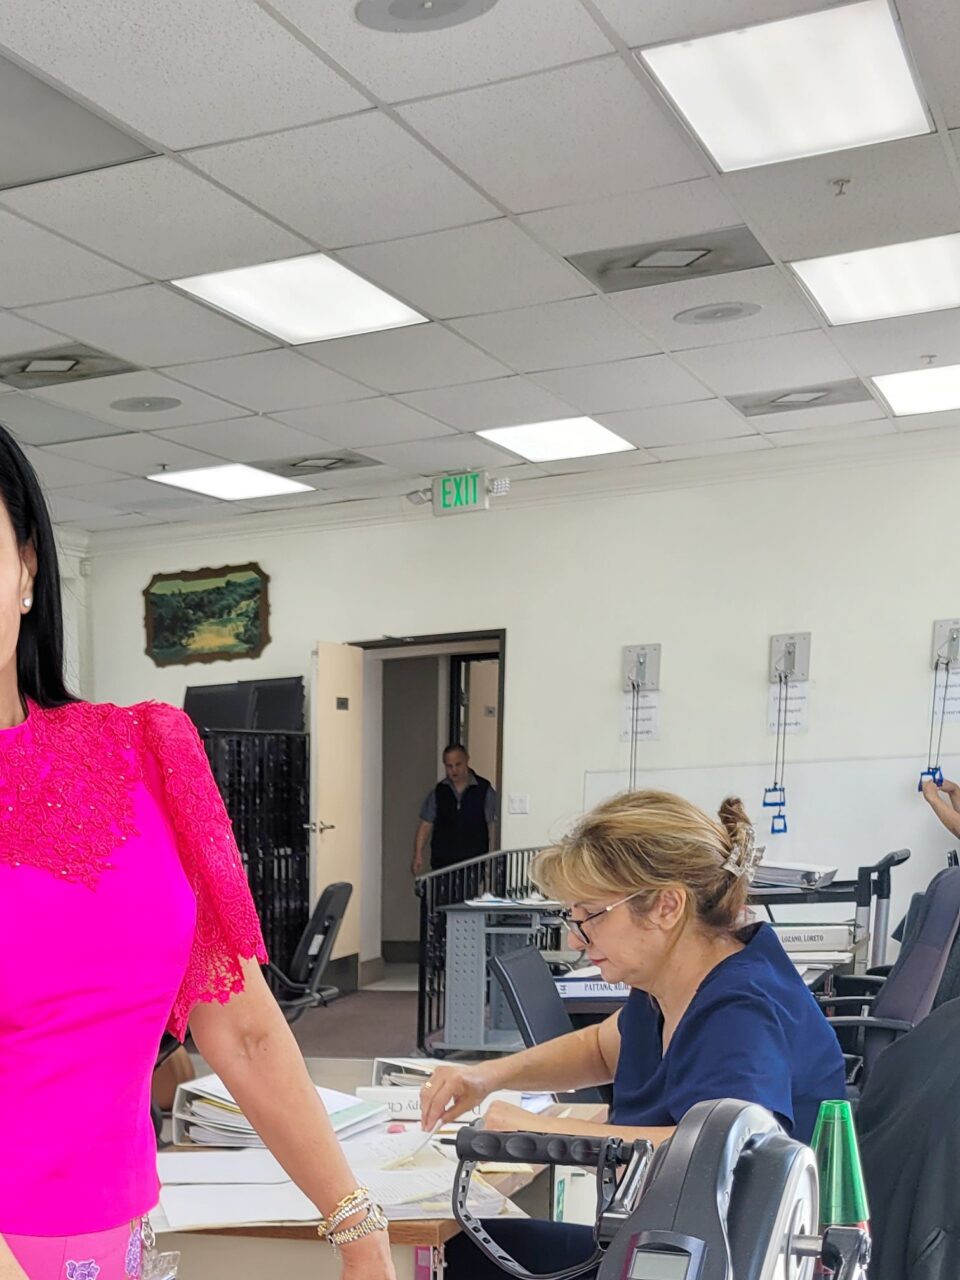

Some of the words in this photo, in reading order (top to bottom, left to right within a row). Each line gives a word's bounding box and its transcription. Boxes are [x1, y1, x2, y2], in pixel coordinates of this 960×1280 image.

[442, 473, 480, 508] EXIT
[782, 935, 803, 943] LOZANO,
[804, 934, 824, 942] LORETO
